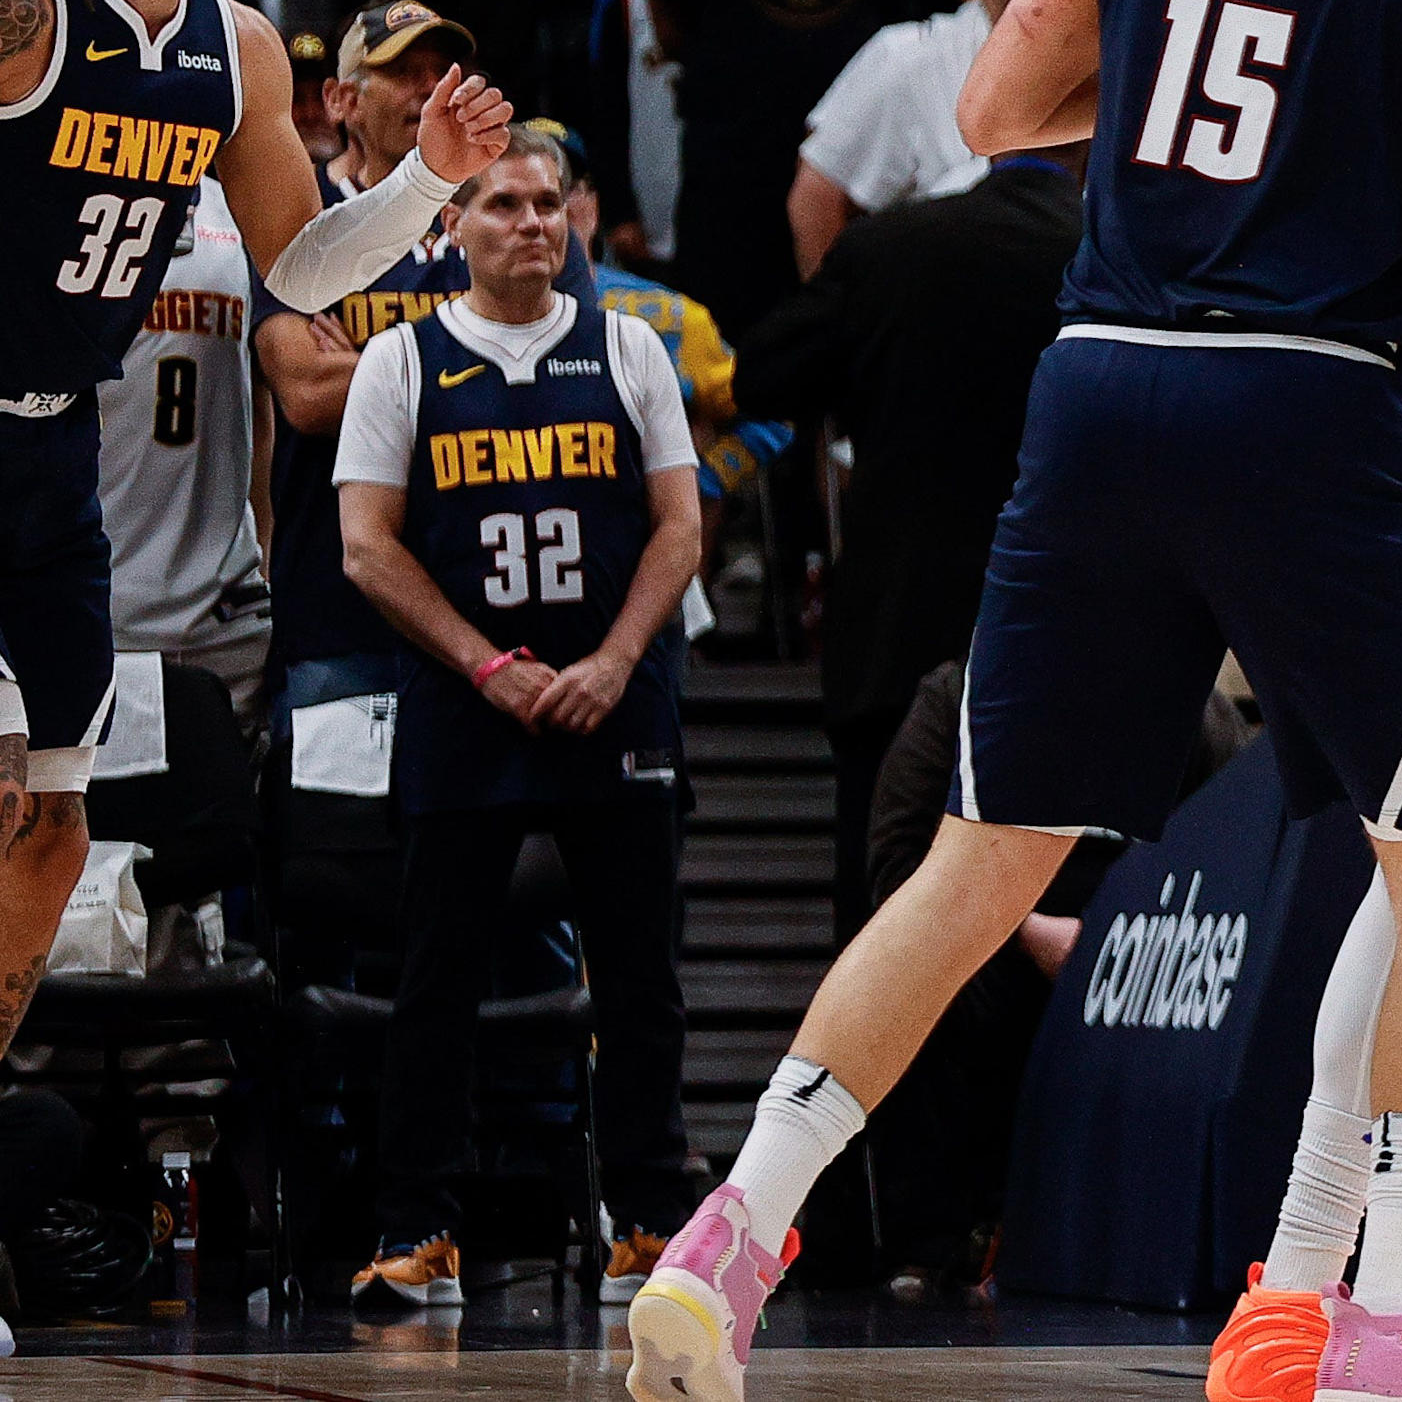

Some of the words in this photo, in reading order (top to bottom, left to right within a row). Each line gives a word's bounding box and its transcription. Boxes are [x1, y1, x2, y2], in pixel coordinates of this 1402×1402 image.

[177, 50, 223, 73] ibotta
[49, 107, 222, 187] DENVER
[56, 193, 166, 298] 32
[153, 354, 198, 447] 8
[547, 358, 602, 377] ibotta
[429, 420, 618, 491] DENVER
[479, 507, 585, 608] 32
[1083, 869, 1249, 1031] coinbase
